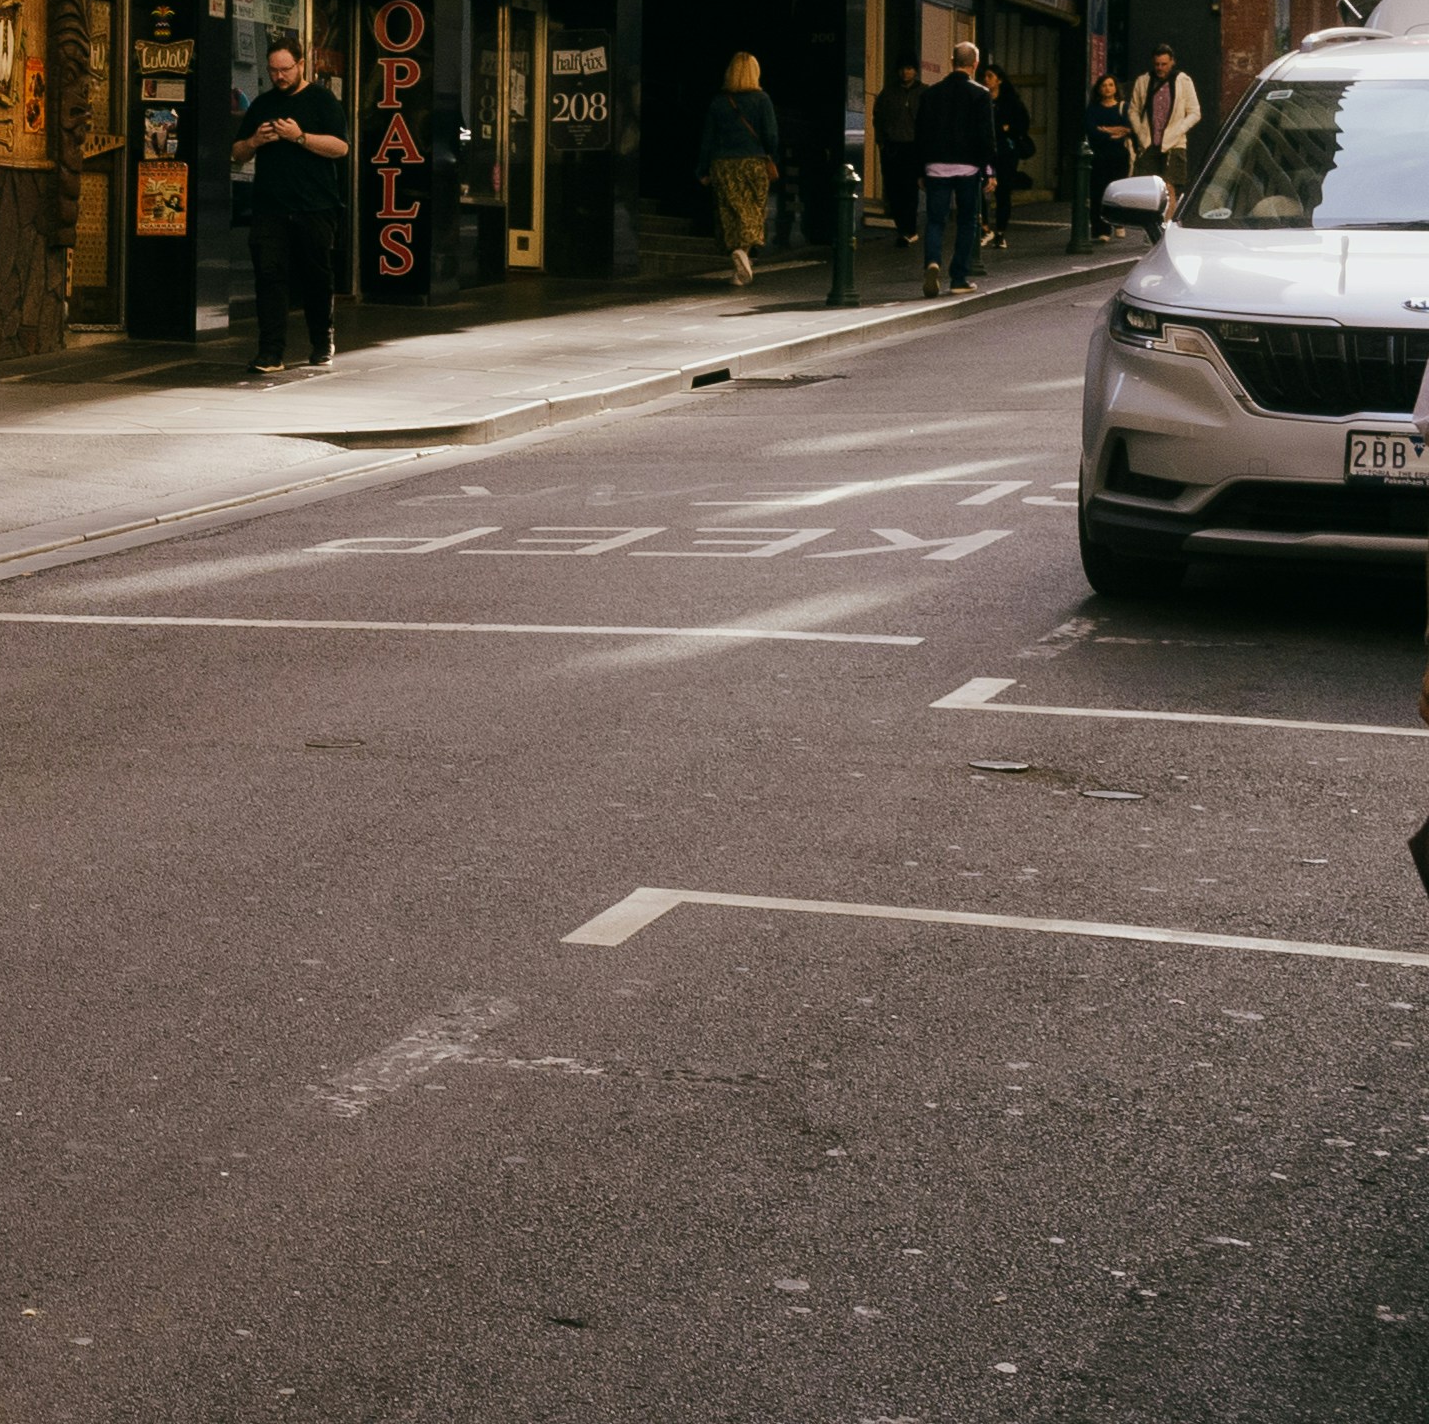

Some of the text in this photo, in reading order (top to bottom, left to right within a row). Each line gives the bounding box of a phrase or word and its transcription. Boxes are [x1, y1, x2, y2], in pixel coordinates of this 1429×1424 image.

[552, 92, 608, 122] 208
[371, 0, 424, 275] OPALS
[302, 526, 1014, 561] KEEP
